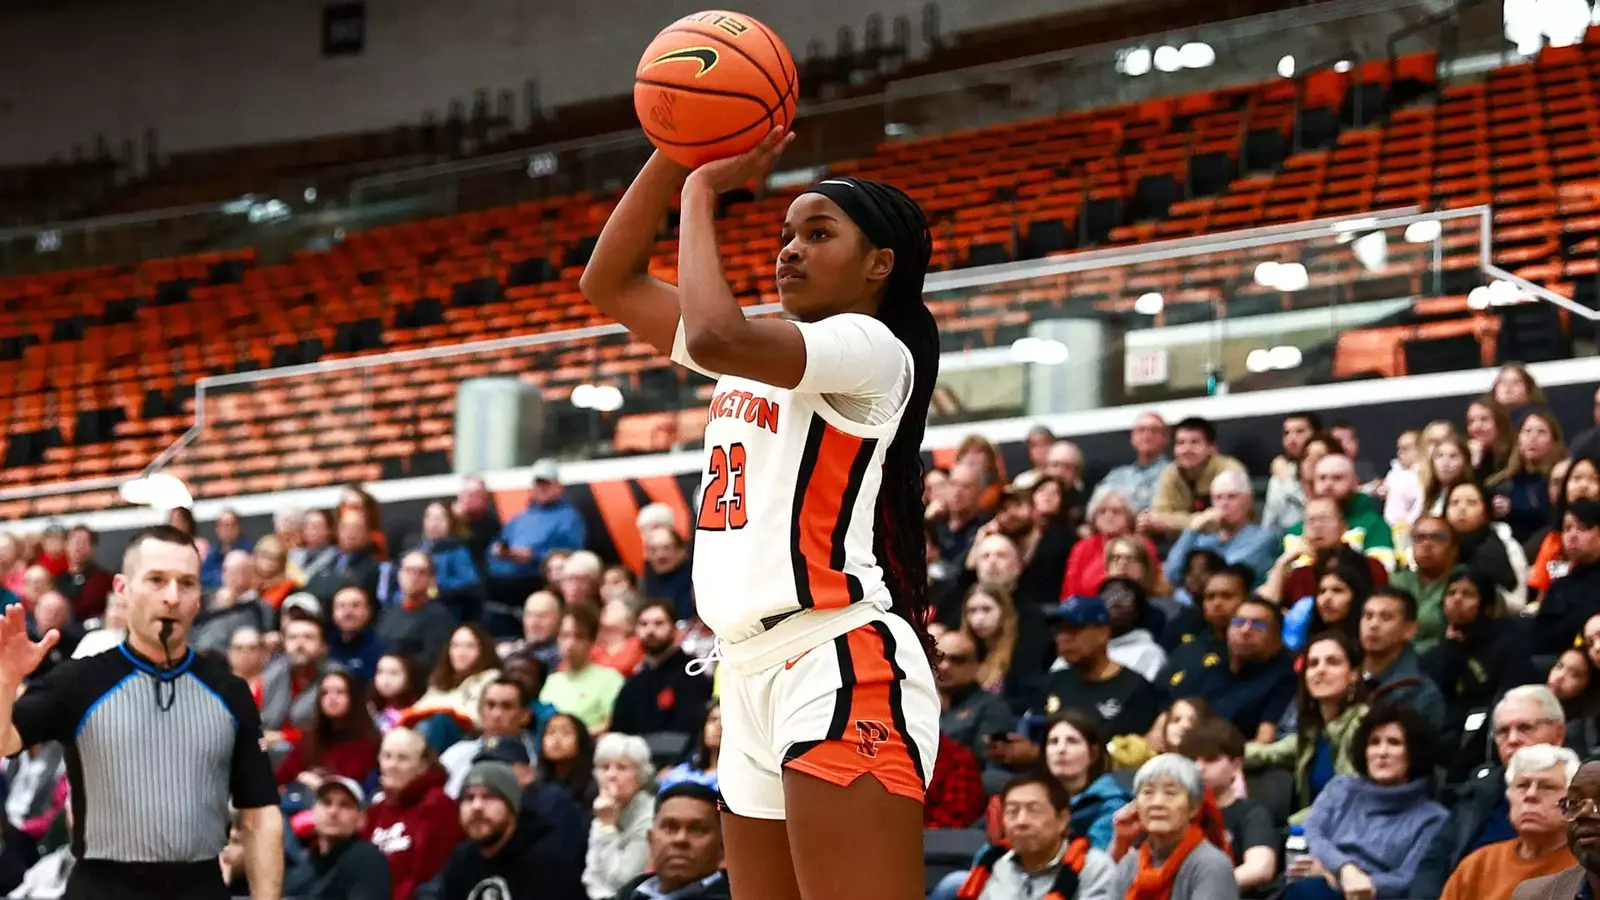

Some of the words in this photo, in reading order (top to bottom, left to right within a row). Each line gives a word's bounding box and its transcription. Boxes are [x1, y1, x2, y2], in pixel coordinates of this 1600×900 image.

[709, 389, 779, 434] NCETON
[696, 442, 748, 531] 23
[855, 719, 890, 758] P
